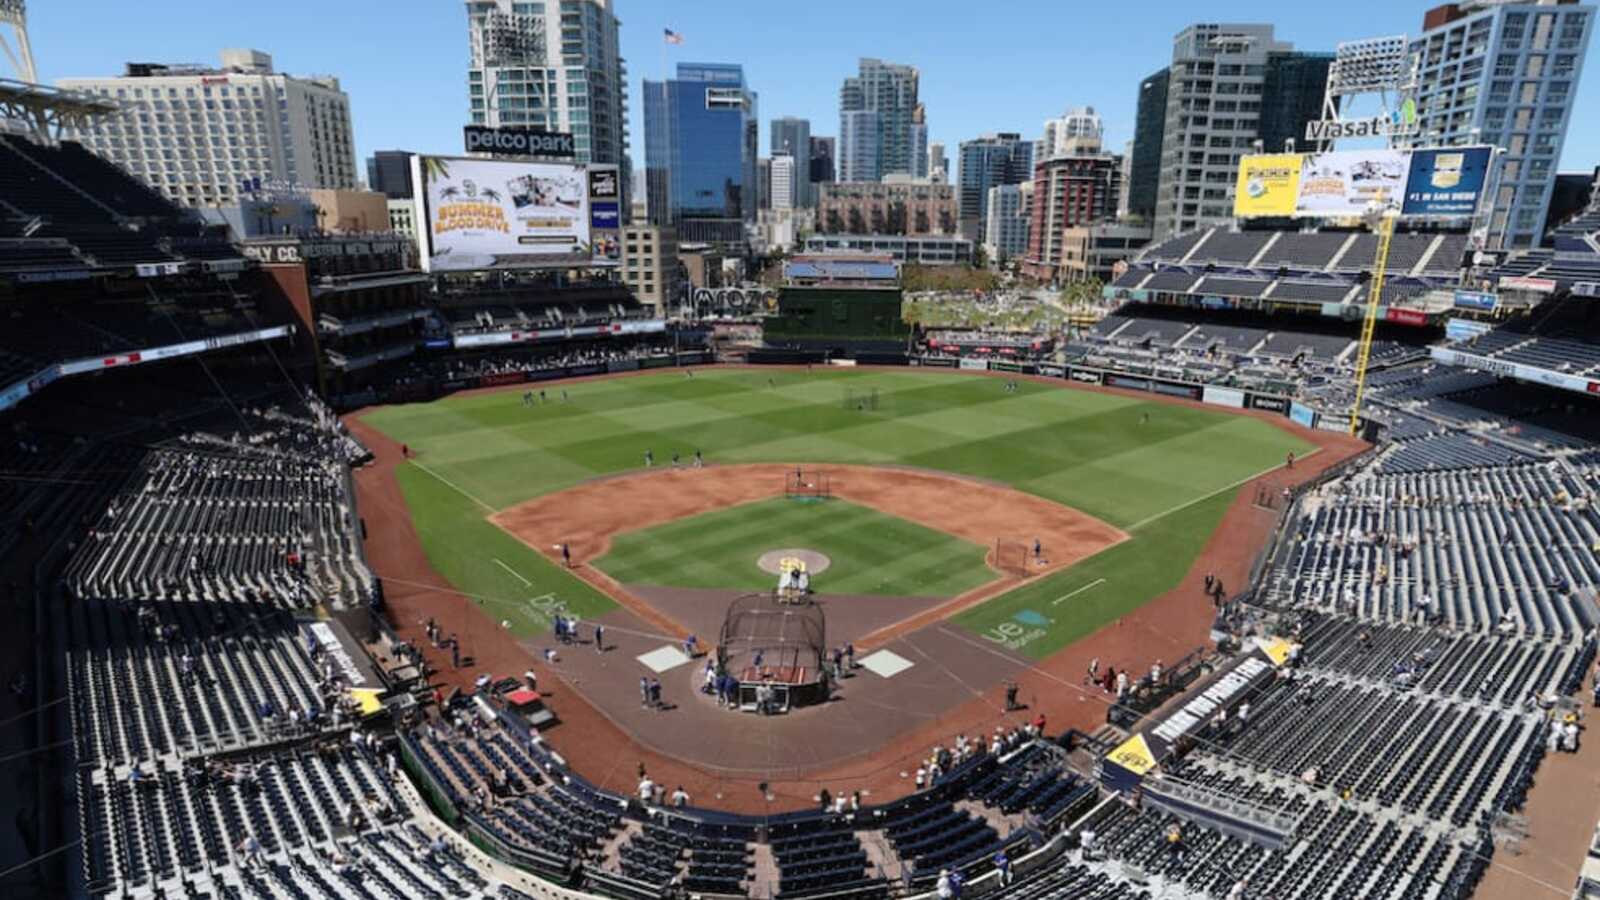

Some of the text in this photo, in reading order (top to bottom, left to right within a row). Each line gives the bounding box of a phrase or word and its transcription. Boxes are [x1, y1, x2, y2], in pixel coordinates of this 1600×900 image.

[1309, 118, 1381, 139] Viasat
[467, 130, 572, 153] petco park
